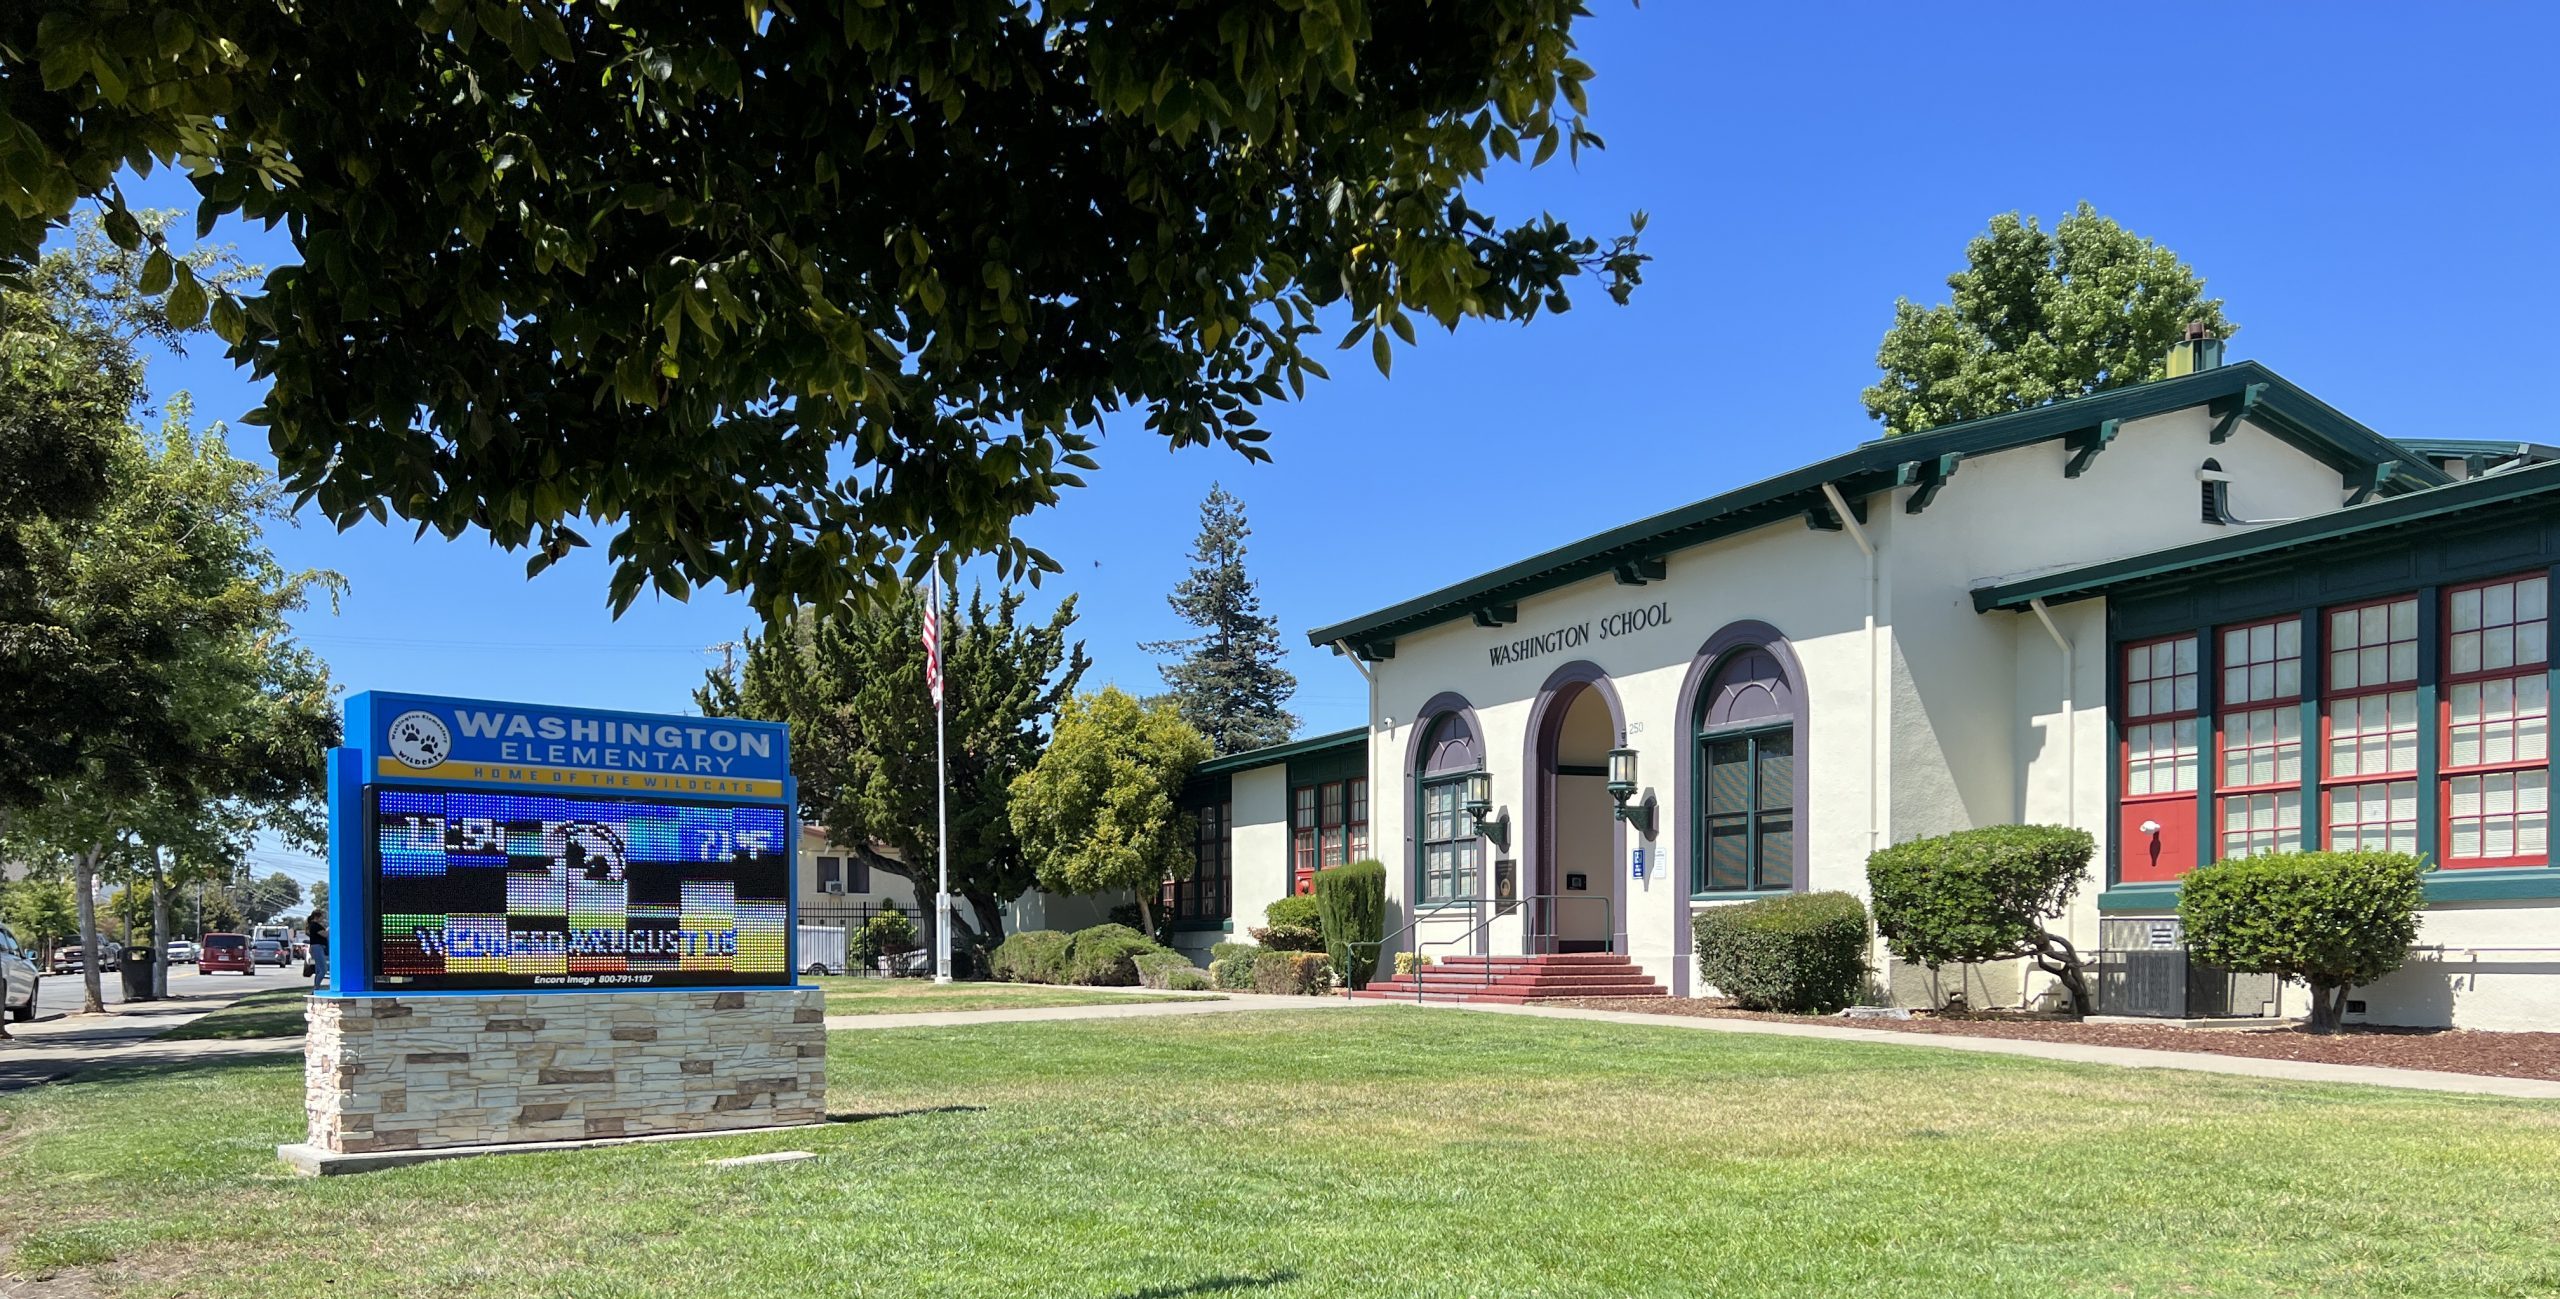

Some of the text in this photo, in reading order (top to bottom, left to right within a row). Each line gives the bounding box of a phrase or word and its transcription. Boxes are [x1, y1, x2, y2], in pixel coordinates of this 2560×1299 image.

[1489, 601, 1672, 668] WASHINGTON SCHOOL
[453, 709, 770, 758] WASHINGTON
[398, 749, 443, 766] WILDCATS
[501, 741, 734, 774] ELEMENTARY
[474, 767, 753, 793] HOME OF THE WILDCATS
[534, 974, 653, 986] Encore Image 800-791-1187
